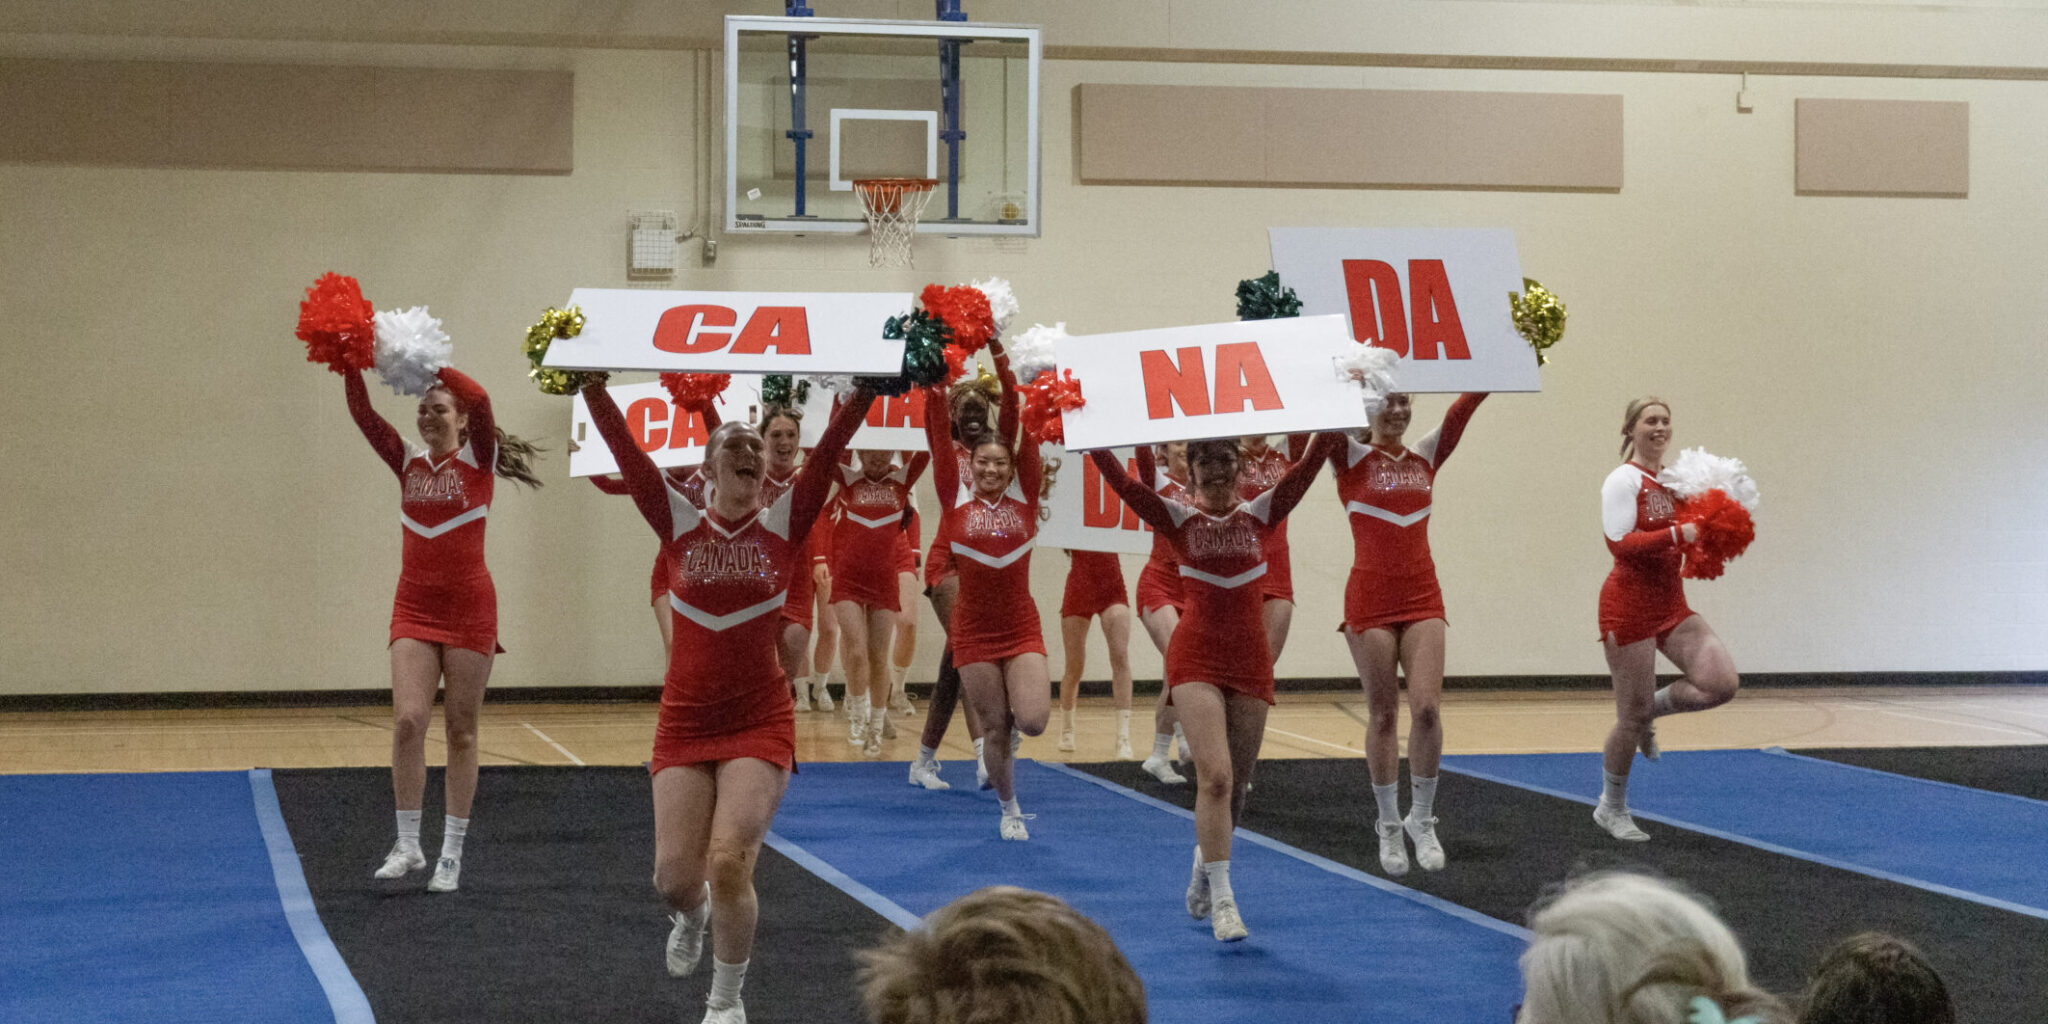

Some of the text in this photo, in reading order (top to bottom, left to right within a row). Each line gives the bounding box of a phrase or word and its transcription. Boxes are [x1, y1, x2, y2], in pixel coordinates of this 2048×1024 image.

[652, 304, 812, 355] CA
[1342, 259, 1472, 360] DA
[1139, 341, 1285, 420] NA
[687, 542, 764, 573] CANADA
[1193, 526, 1253, 549] CANADA
